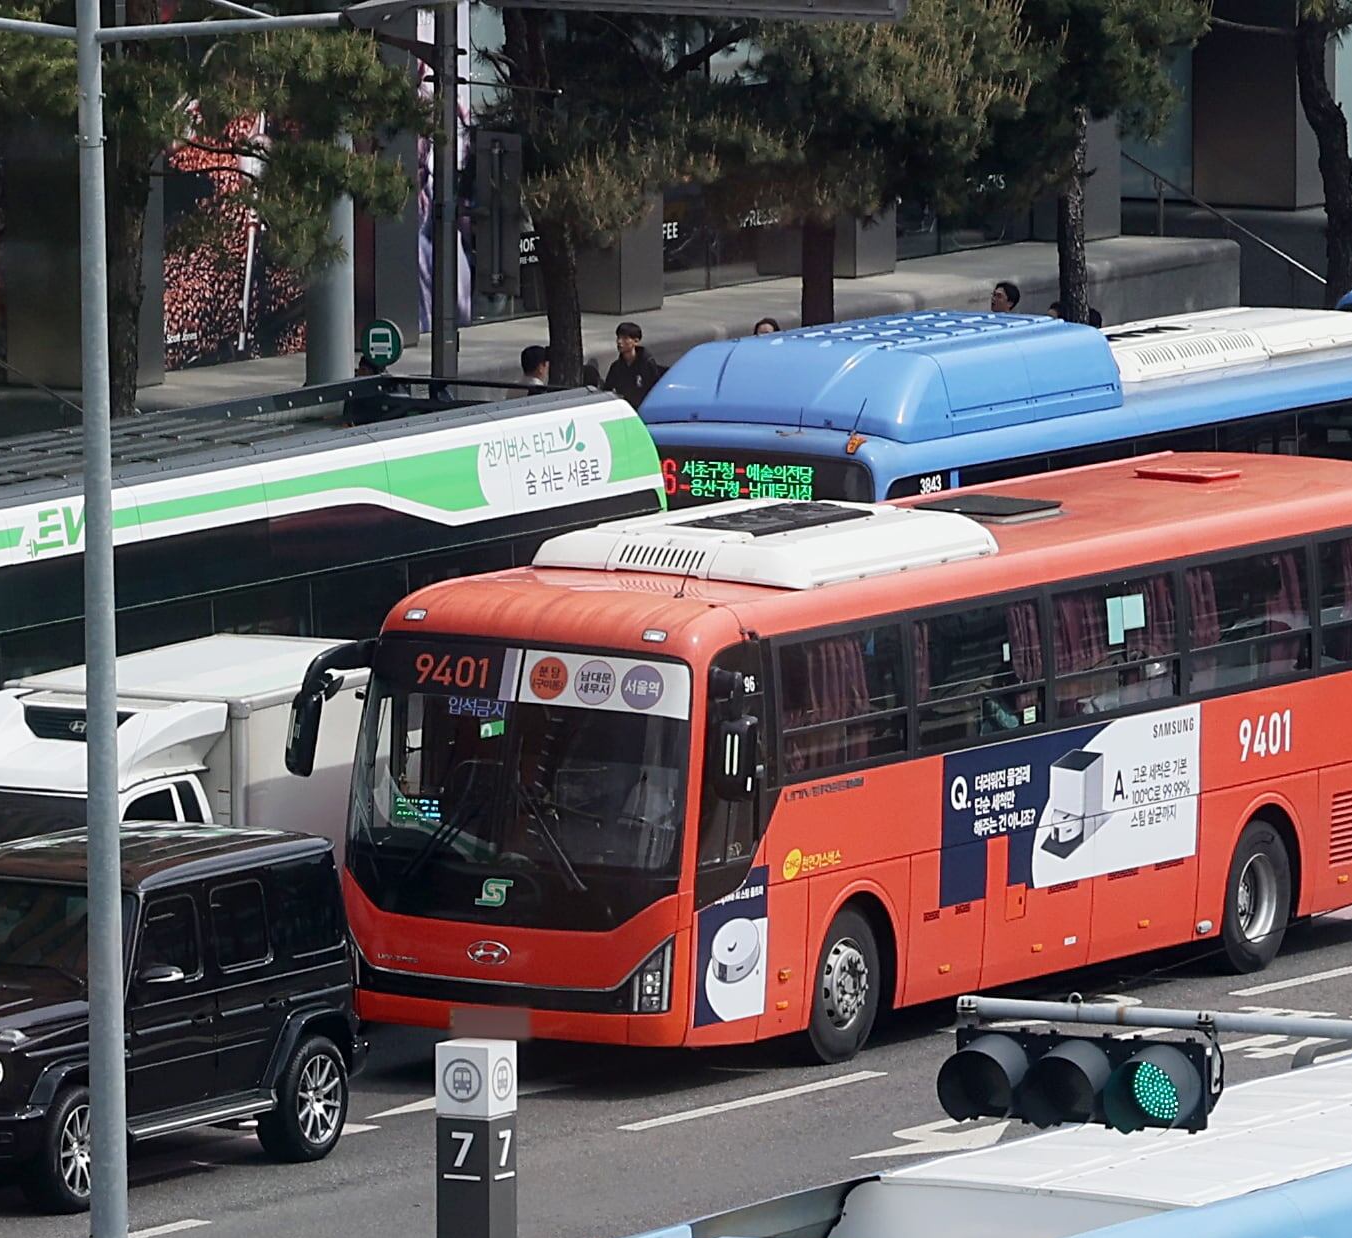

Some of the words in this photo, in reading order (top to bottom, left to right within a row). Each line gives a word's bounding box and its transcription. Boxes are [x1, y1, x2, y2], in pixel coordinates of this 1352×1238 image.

[484, 435, 531, 467] 전기버스
[533, 431, 555, 458] 타고
[525, 468, 538, 496] 숨
[541, 463, 564, 494] 쉬는
[567, 458, 602, 488] 서울로
[681, 460, 735, 478] 서초구청
[746, 463, 814, 485] 예술의전당
[919, 474, 943, 495] 3843
[415, 652, 490, 690] 9401
[580, 670, 612, 684] 남대문
[578, 683, 611, 697] 세무서
[624, 677, 660, 697] 서울역
[447, 695, 508, 718] 입석금지
[1153, 717, 1195, 739] SAMSUNG
[1239, 709, 1292, 762] 9401
[1131, 766, 1148, 785] 고온
[1148, 762, 1172, 781] 세척은
[1172, 757, 1188, 776] 기본
[451, 1131, 475, 1168] 7
[497, 1128, 513, 1167] 7
